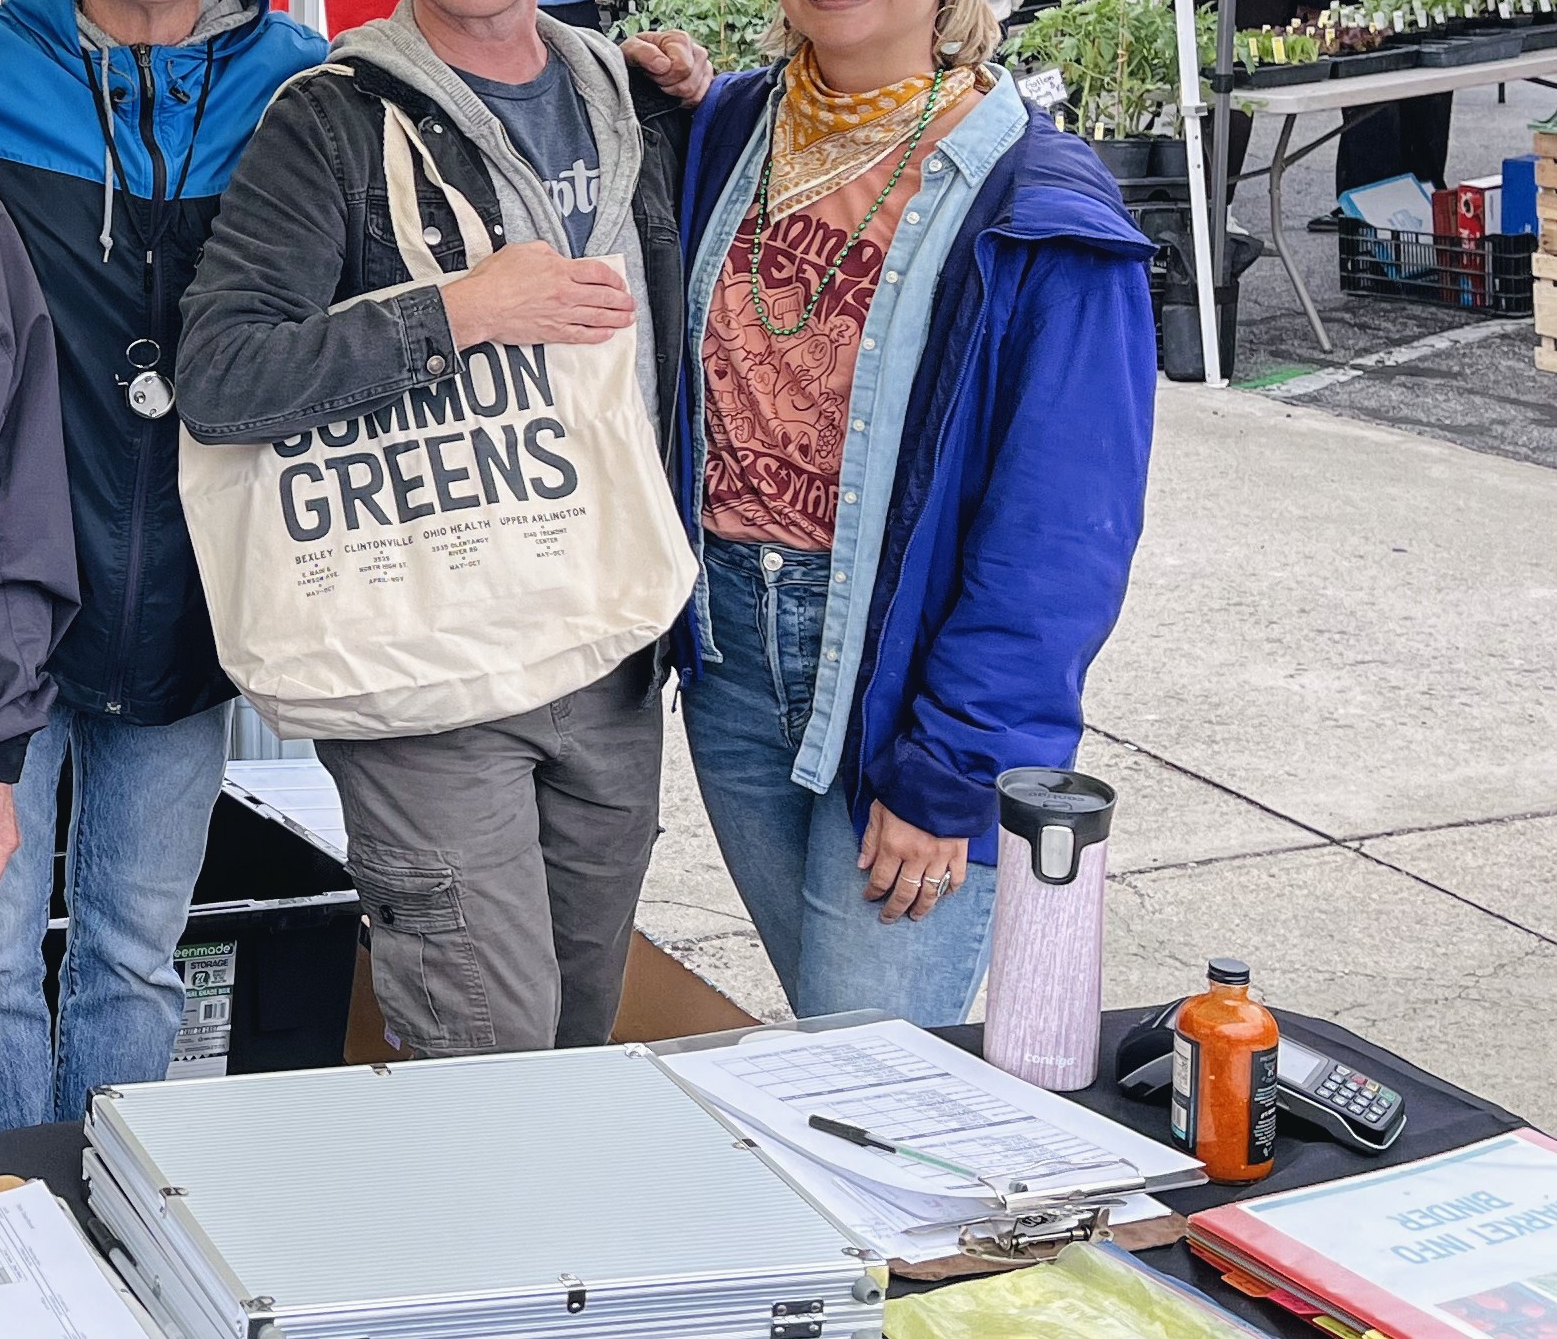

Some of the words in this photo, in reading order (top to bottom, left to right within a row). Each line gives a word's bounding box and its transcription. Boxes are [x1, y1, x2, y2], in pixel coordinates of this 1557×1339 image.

[279, 417, 577, 542] GREENS
[499, 515, 528, 526] UPPER
[531, 507, 586, 523] ARLINGTON
[423, 527, 447, 540] OHIO
[450, 519, 491, 534] HEALTH
[344, 535, 414, 553] CLINTONVILLE
[295, 548, 334, 565] BEXLEY
[190, 958, 228, 970] STORAGE
[1024, 1051, 1077, 1068] contigo
[1386, 1191, 1514, 1231] BINDER
[1466, 1202, 1557, 1246] ARKET
[1390, 1234, 1476, 1264] INFO
